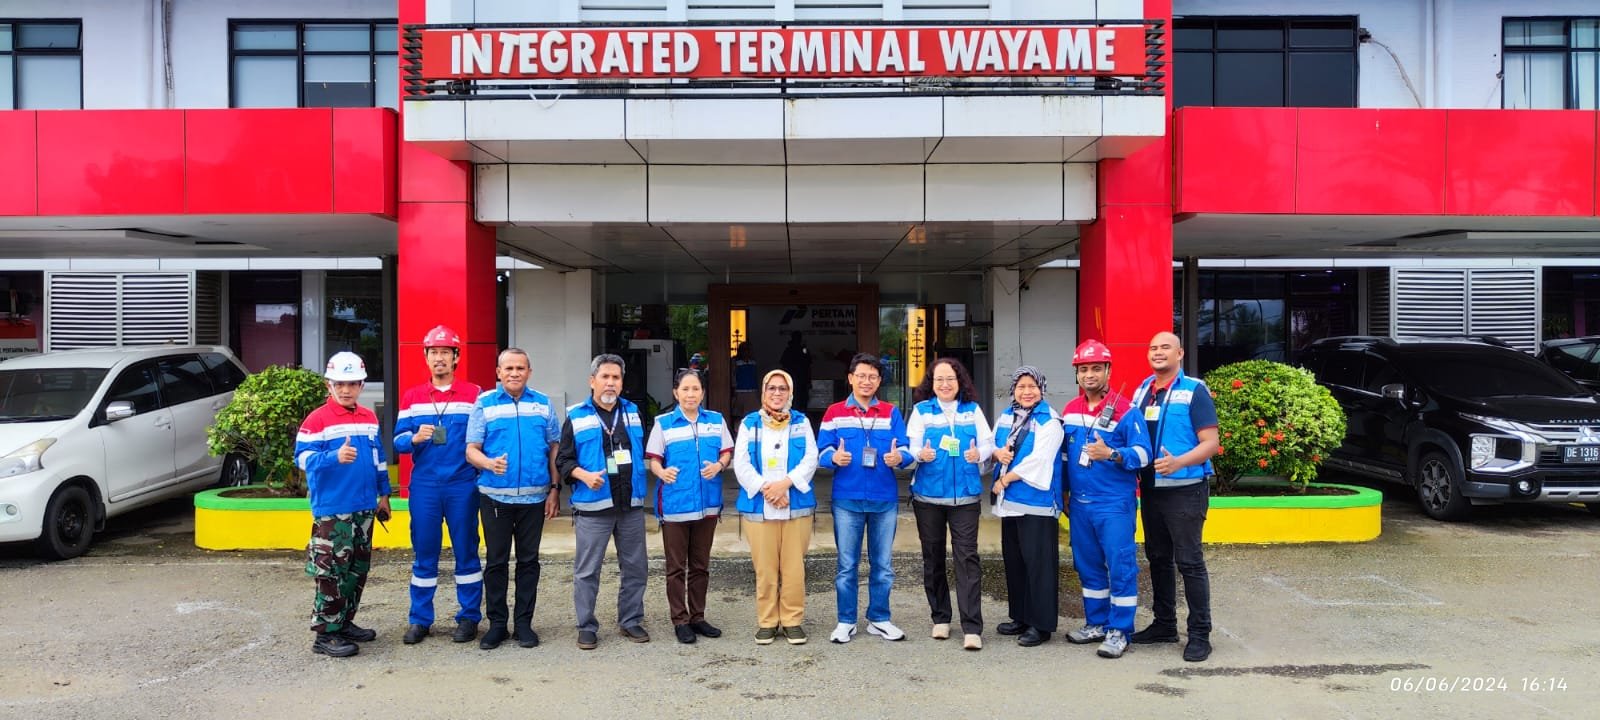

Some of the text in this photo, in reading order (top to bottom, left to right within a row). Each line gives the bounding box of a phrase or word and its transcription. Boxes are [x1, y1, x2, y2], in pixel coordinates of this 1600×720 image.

[451, 28, 1116, 74] INTEGRATED TERMINAL WAYAME
[812, 308, 856, 318] PERTAM
[1567, 447, 1599, 457] DE 1316
